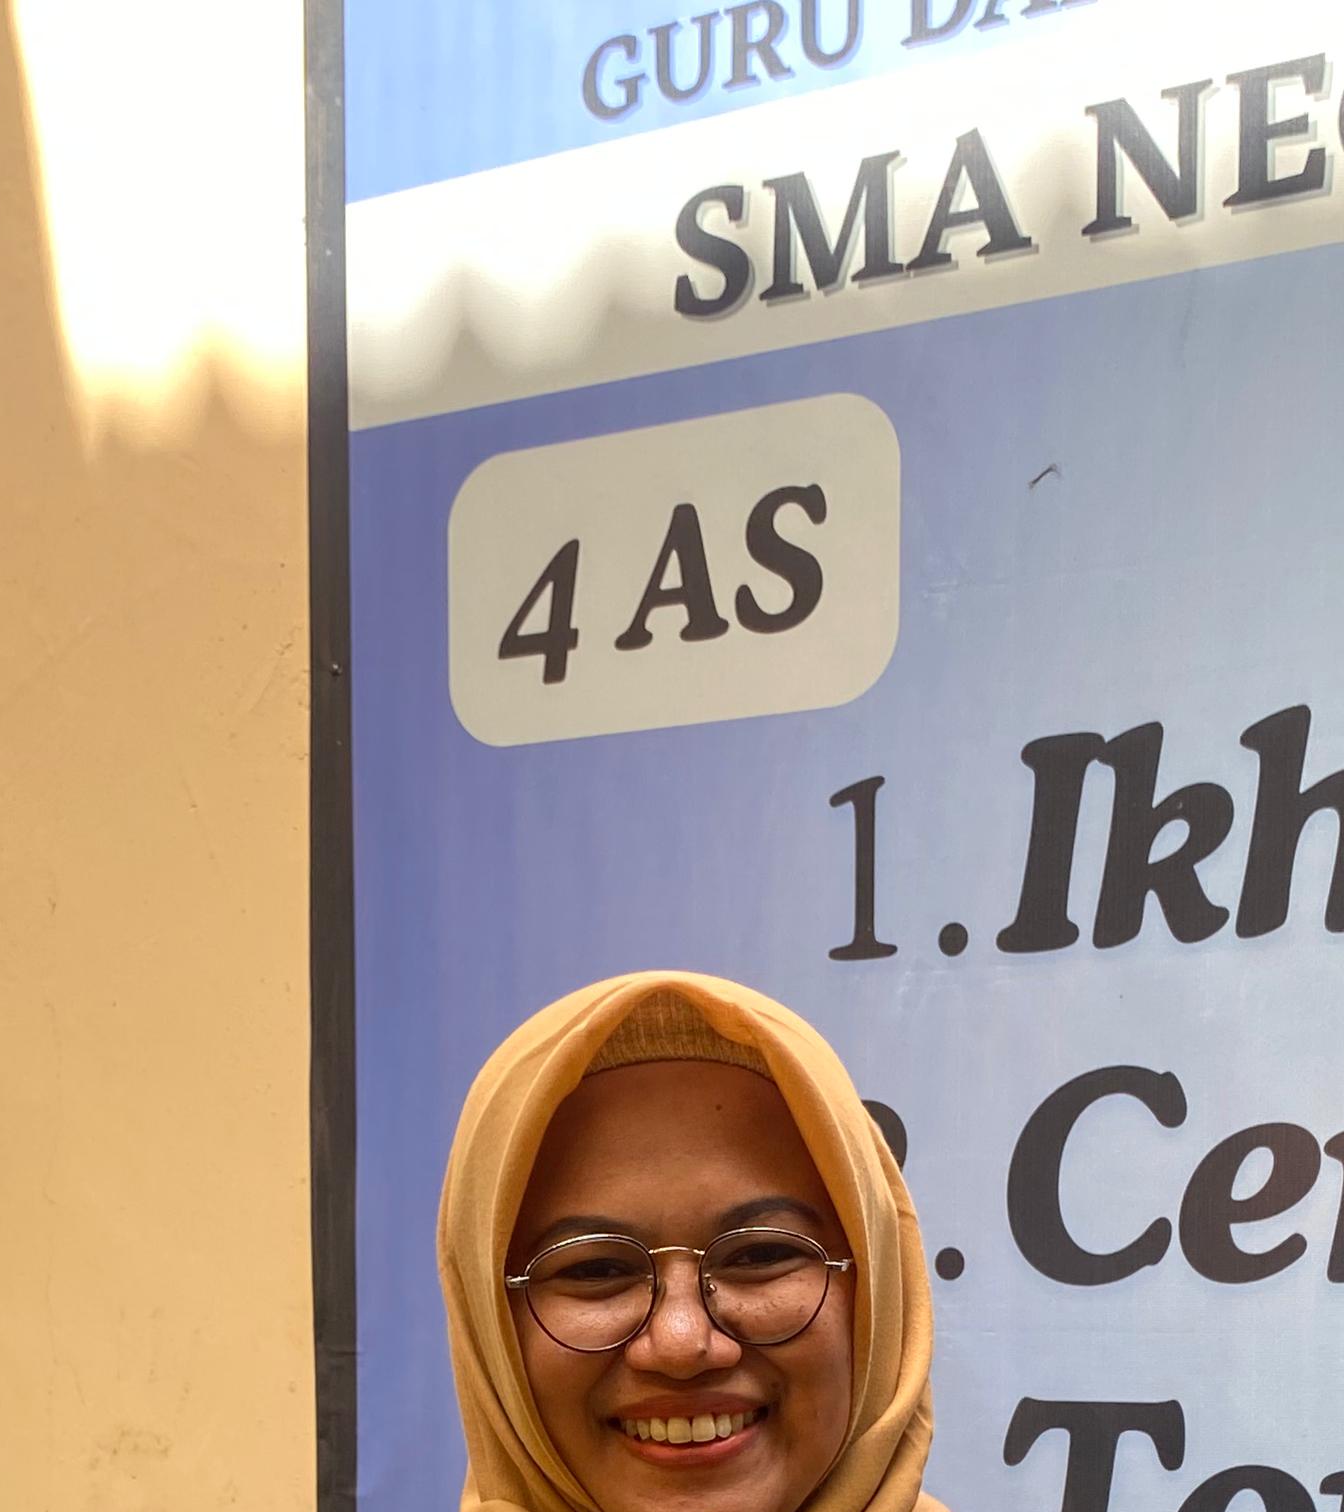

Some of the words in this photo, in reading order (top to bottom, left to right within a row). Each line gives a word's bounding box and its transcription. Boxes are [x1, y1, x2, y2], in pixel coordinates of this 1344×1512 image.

[582, 0, 860, 120] GURU
[674, 128, 1035, 320] SMA
[498, 538, 580, 684] 4
[614, 483, 827, 651] AS
[828, 775, 969, 961] 1.
